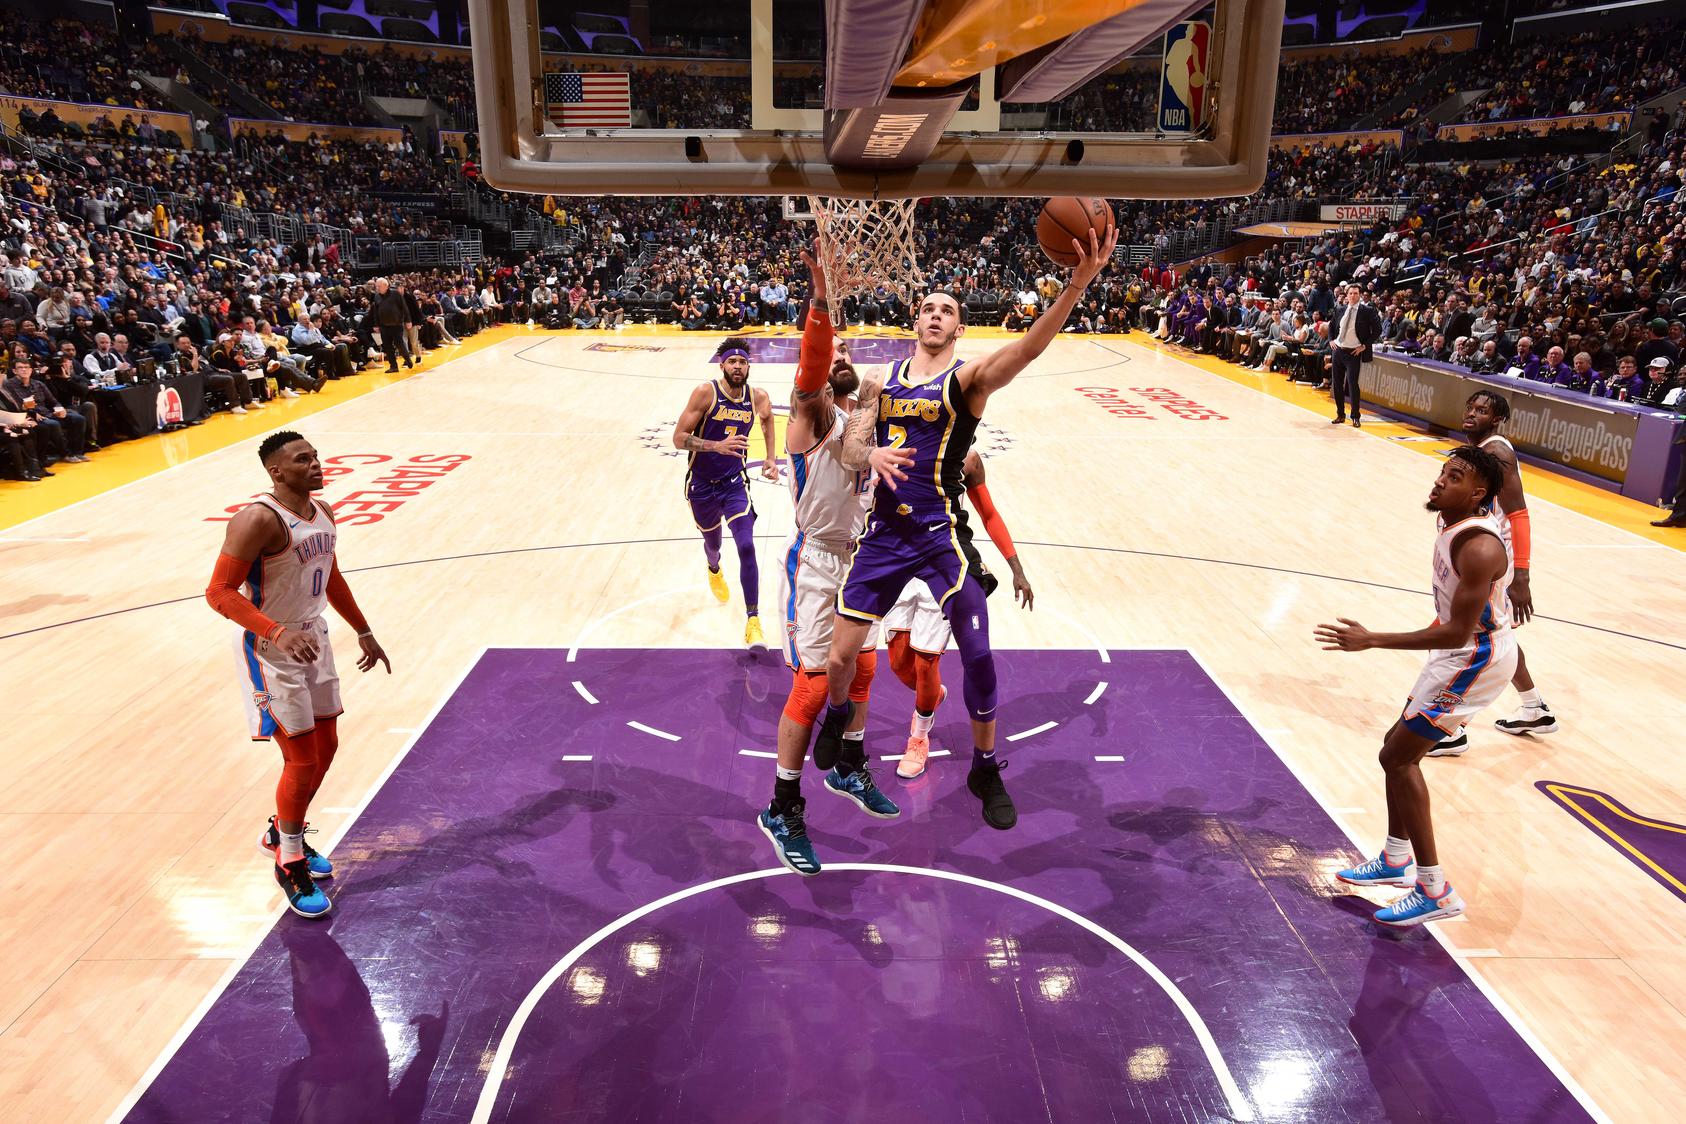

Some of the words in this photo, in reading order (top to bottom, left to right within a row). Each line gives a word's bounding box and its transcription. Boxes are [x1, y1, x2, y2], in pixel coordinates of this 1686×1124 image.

[1164, 109, 1185, 126] NBA
[862, 114, 929, 159] LAKERS.COM
[1074, 386, 1158, 420] Center
[1128, 387, 1229, 421] STAPLES
[1375, 365, 1408, 407] League
[1407, 374, 1434, 413] Pass
[1498, 408, 1632, 472] .com/LeaguePass
[294, 532, 336, 566] THUNDE
[312, 567, 323, 597] 0
